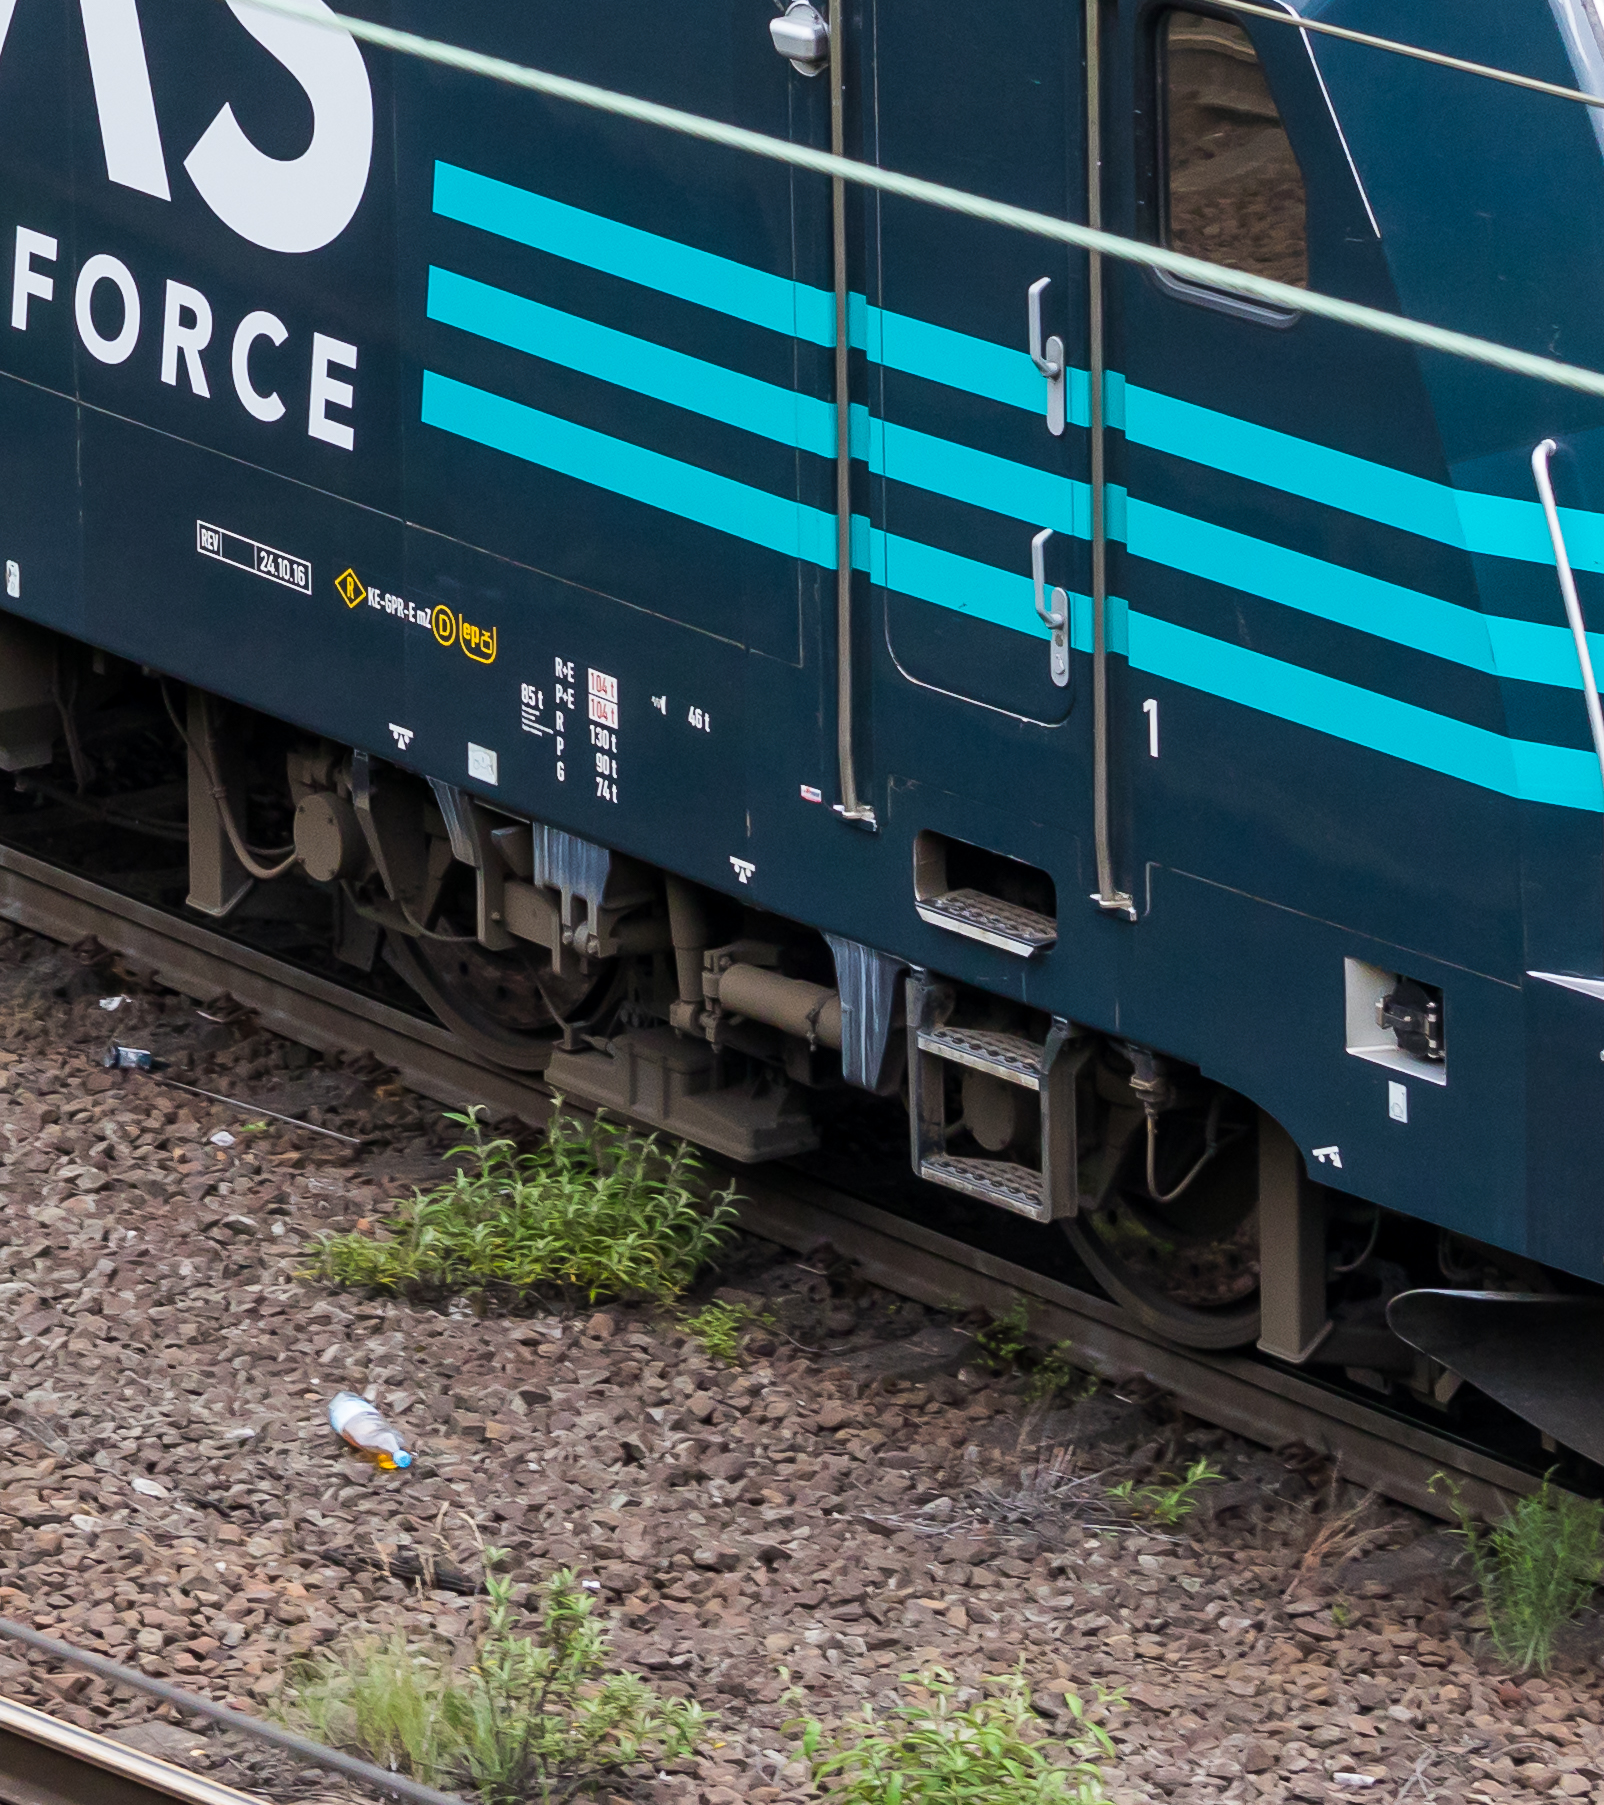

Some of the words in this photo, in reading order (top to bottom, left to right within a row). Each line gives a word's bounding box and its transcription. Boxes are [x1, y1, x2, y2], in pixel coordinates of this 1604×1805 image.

[12, 225, 359, 452] FORCE
[201, 528, 219, 552] REV
[259, 550, 306, 587] 24.10.16
[345, 576, 355, 600] R
[367, 586, 416, 623] KE-GPR-E
[440, 613, 451, 637] D
[463, 621, 480, 647] ep
[521, 682, 536, 706] 85
[537, 690, 544, 709] t
[555, 656, 575, 683] R+E
[590, 672, 608, 697] 104
[555, 683, 575, 710] P+E
[590, 698, 608, 723] 104
[688, 705, 703, 729] 46
[704, 712, 711, 733] t
[555, 710, 565, 733] R
[589, 724, 610, 750] 130
[610, 733, 618, 754] t
[1143, 698, 1159, 758] 1
[556, 736, 565, 756] P
[595, 752, 610, 776] 90
[611, 759, 618, 779] t
[556, 760, 565, 782] G
[595, 776, 610, 801] 74
[611, 784, 619, 804] t
